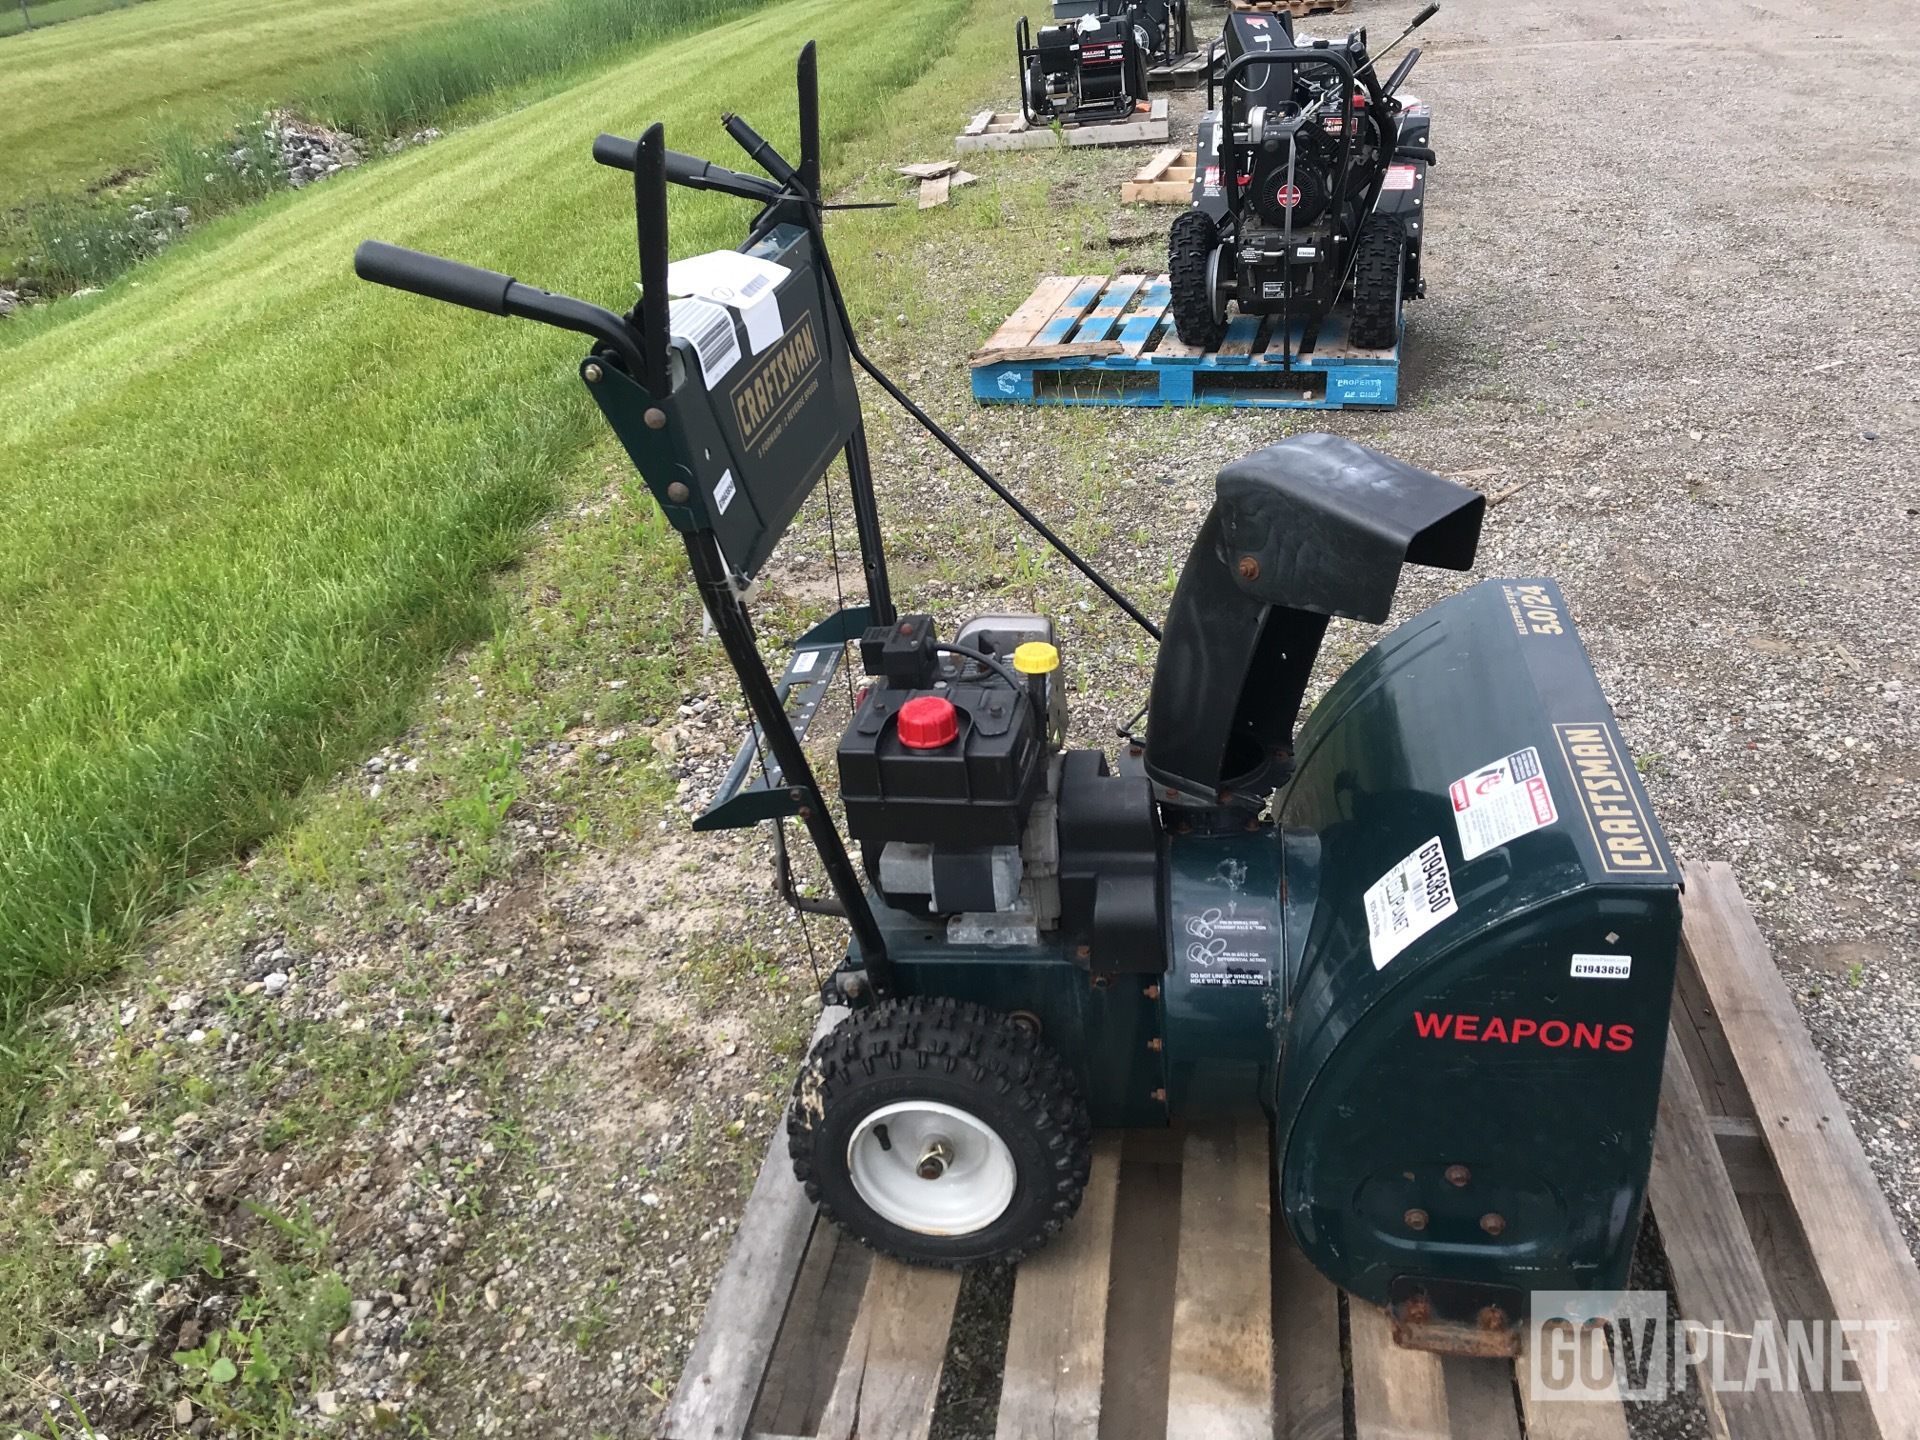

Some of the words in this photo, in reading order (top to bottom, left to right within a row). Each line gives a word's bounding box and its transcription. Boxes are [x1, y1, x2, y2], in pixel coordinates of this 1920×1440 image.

[737, 322, 816, 436] CRAFTSMAN
[787, 395, 805, 423] REVERSE
[804, 378, 819, 401] SPEEDS
[1502, 585, 1517, 604] START
[1517, 585, 1563, 635] 5.0/24
[1510, 605, 1529, 635] ELECTRIC
[1532, 787, 1552, 823] DANGER
[1565, 729, 1653, 866] CRAFTSMAN
[1419, 843, 1451, 913] G1943850
[1575, 965, 1629, 975] G1943850
[1414, 1012, 1634, 1051] WEAPONS
